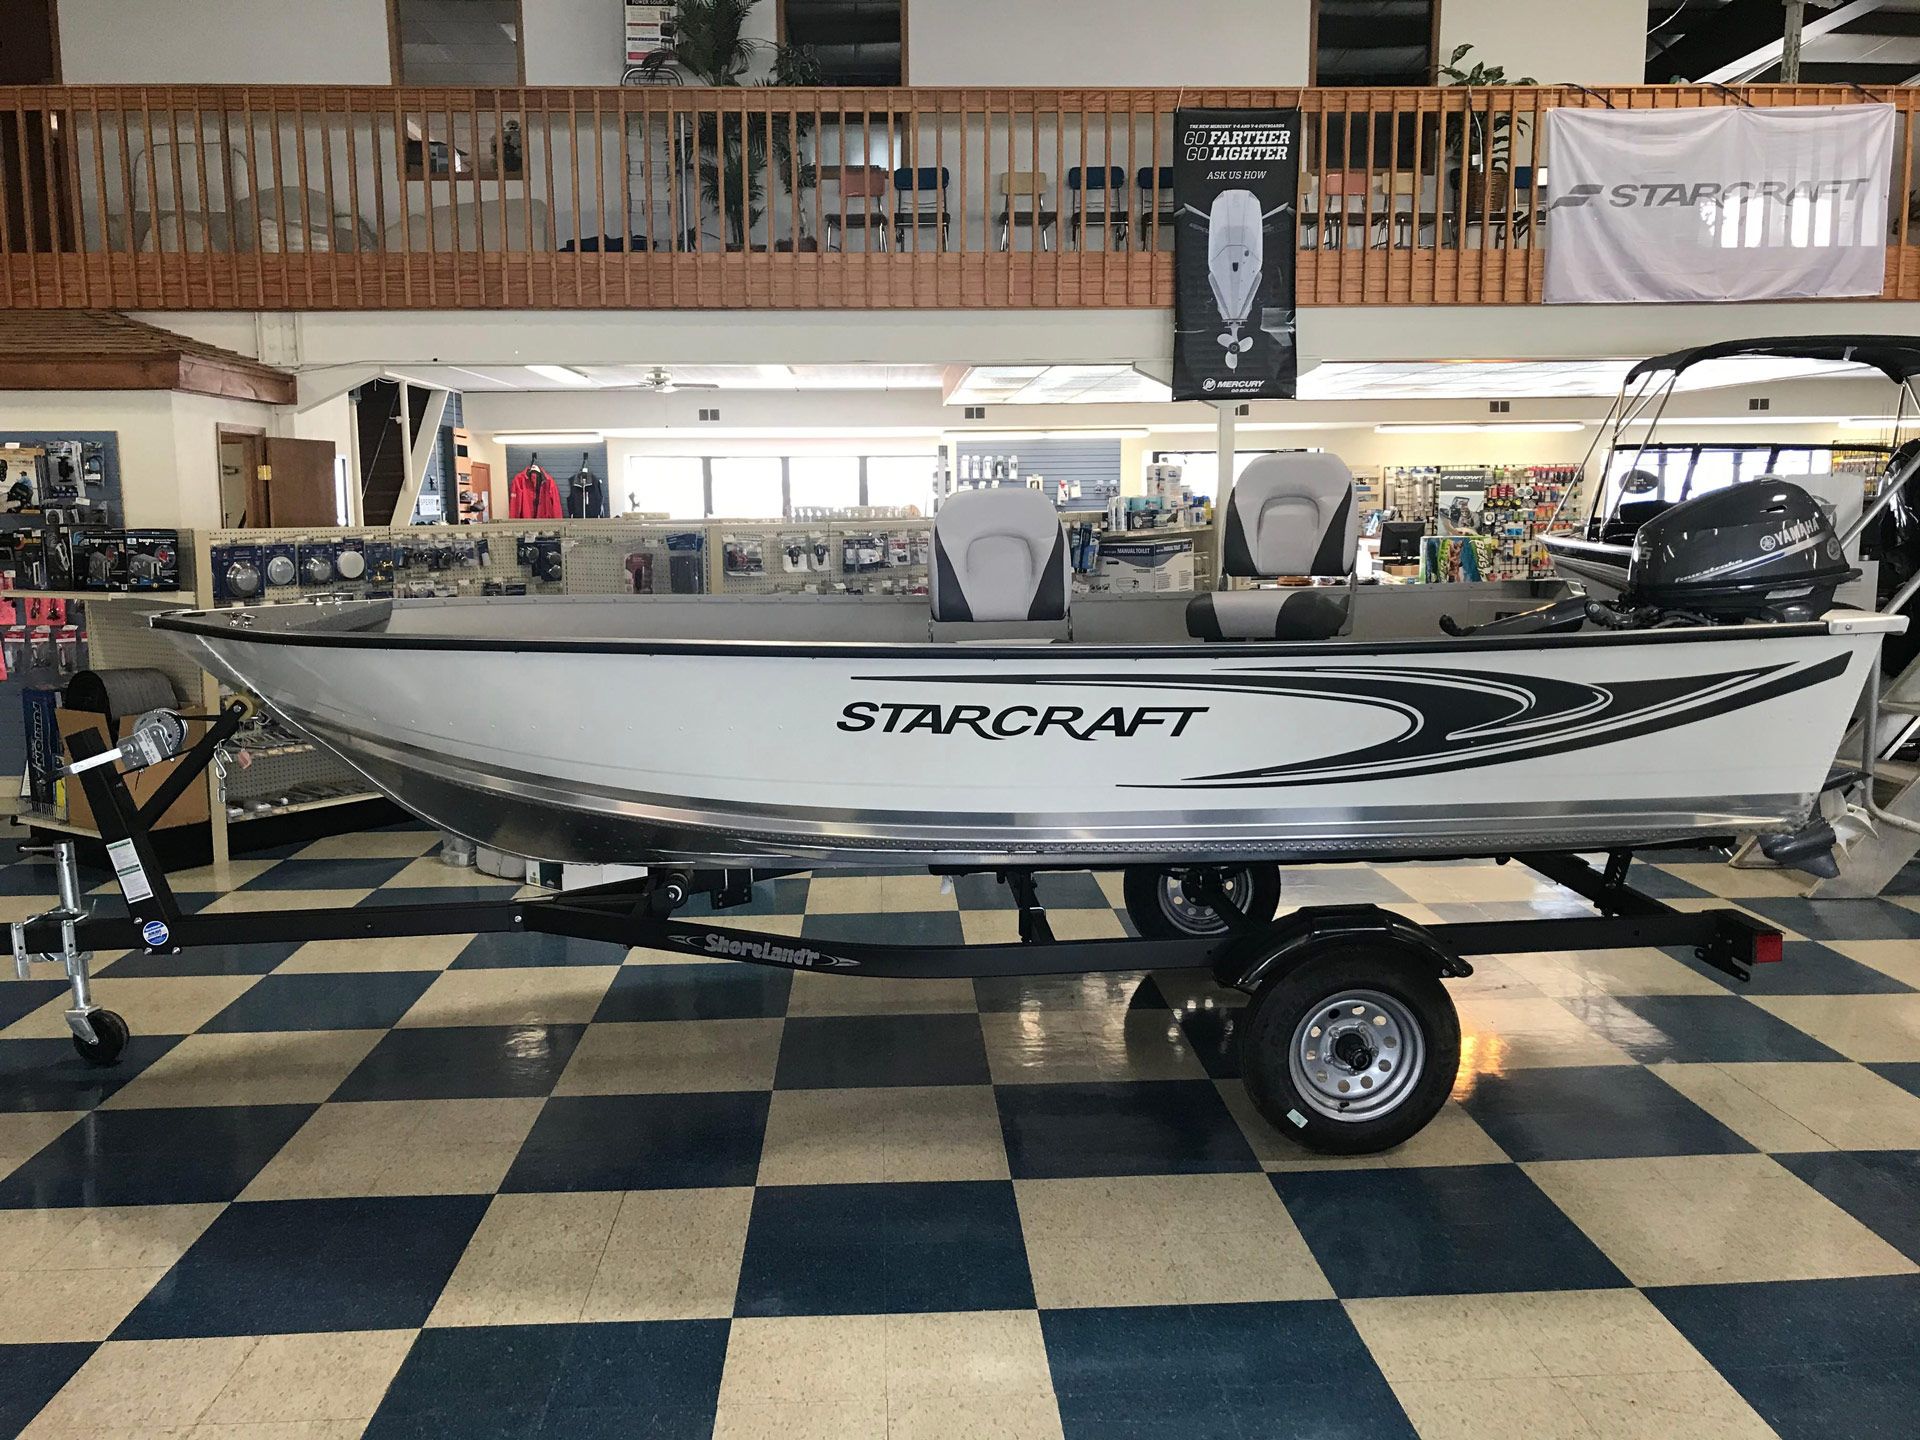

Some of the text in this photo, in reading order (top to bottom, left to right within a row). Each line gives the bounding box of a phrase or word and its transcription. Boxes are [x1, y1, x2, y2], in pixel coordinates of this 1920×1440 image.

[1184, 131, 1291, 145] GO FARTHER
[1186, 146, 1288, 161] GO LIGHTER
[1206, 170, 1267, 179] ASK US HOW
[1608, 177, 1871, 208] STARCRAFT
[1217, 380, 1265, 388] MERCURY
[1774, 516, 1820, 546] YAMAHA
[836, 701, 1211, 741] STARCRAFT
[32, 701, 45, 767] FULTON
